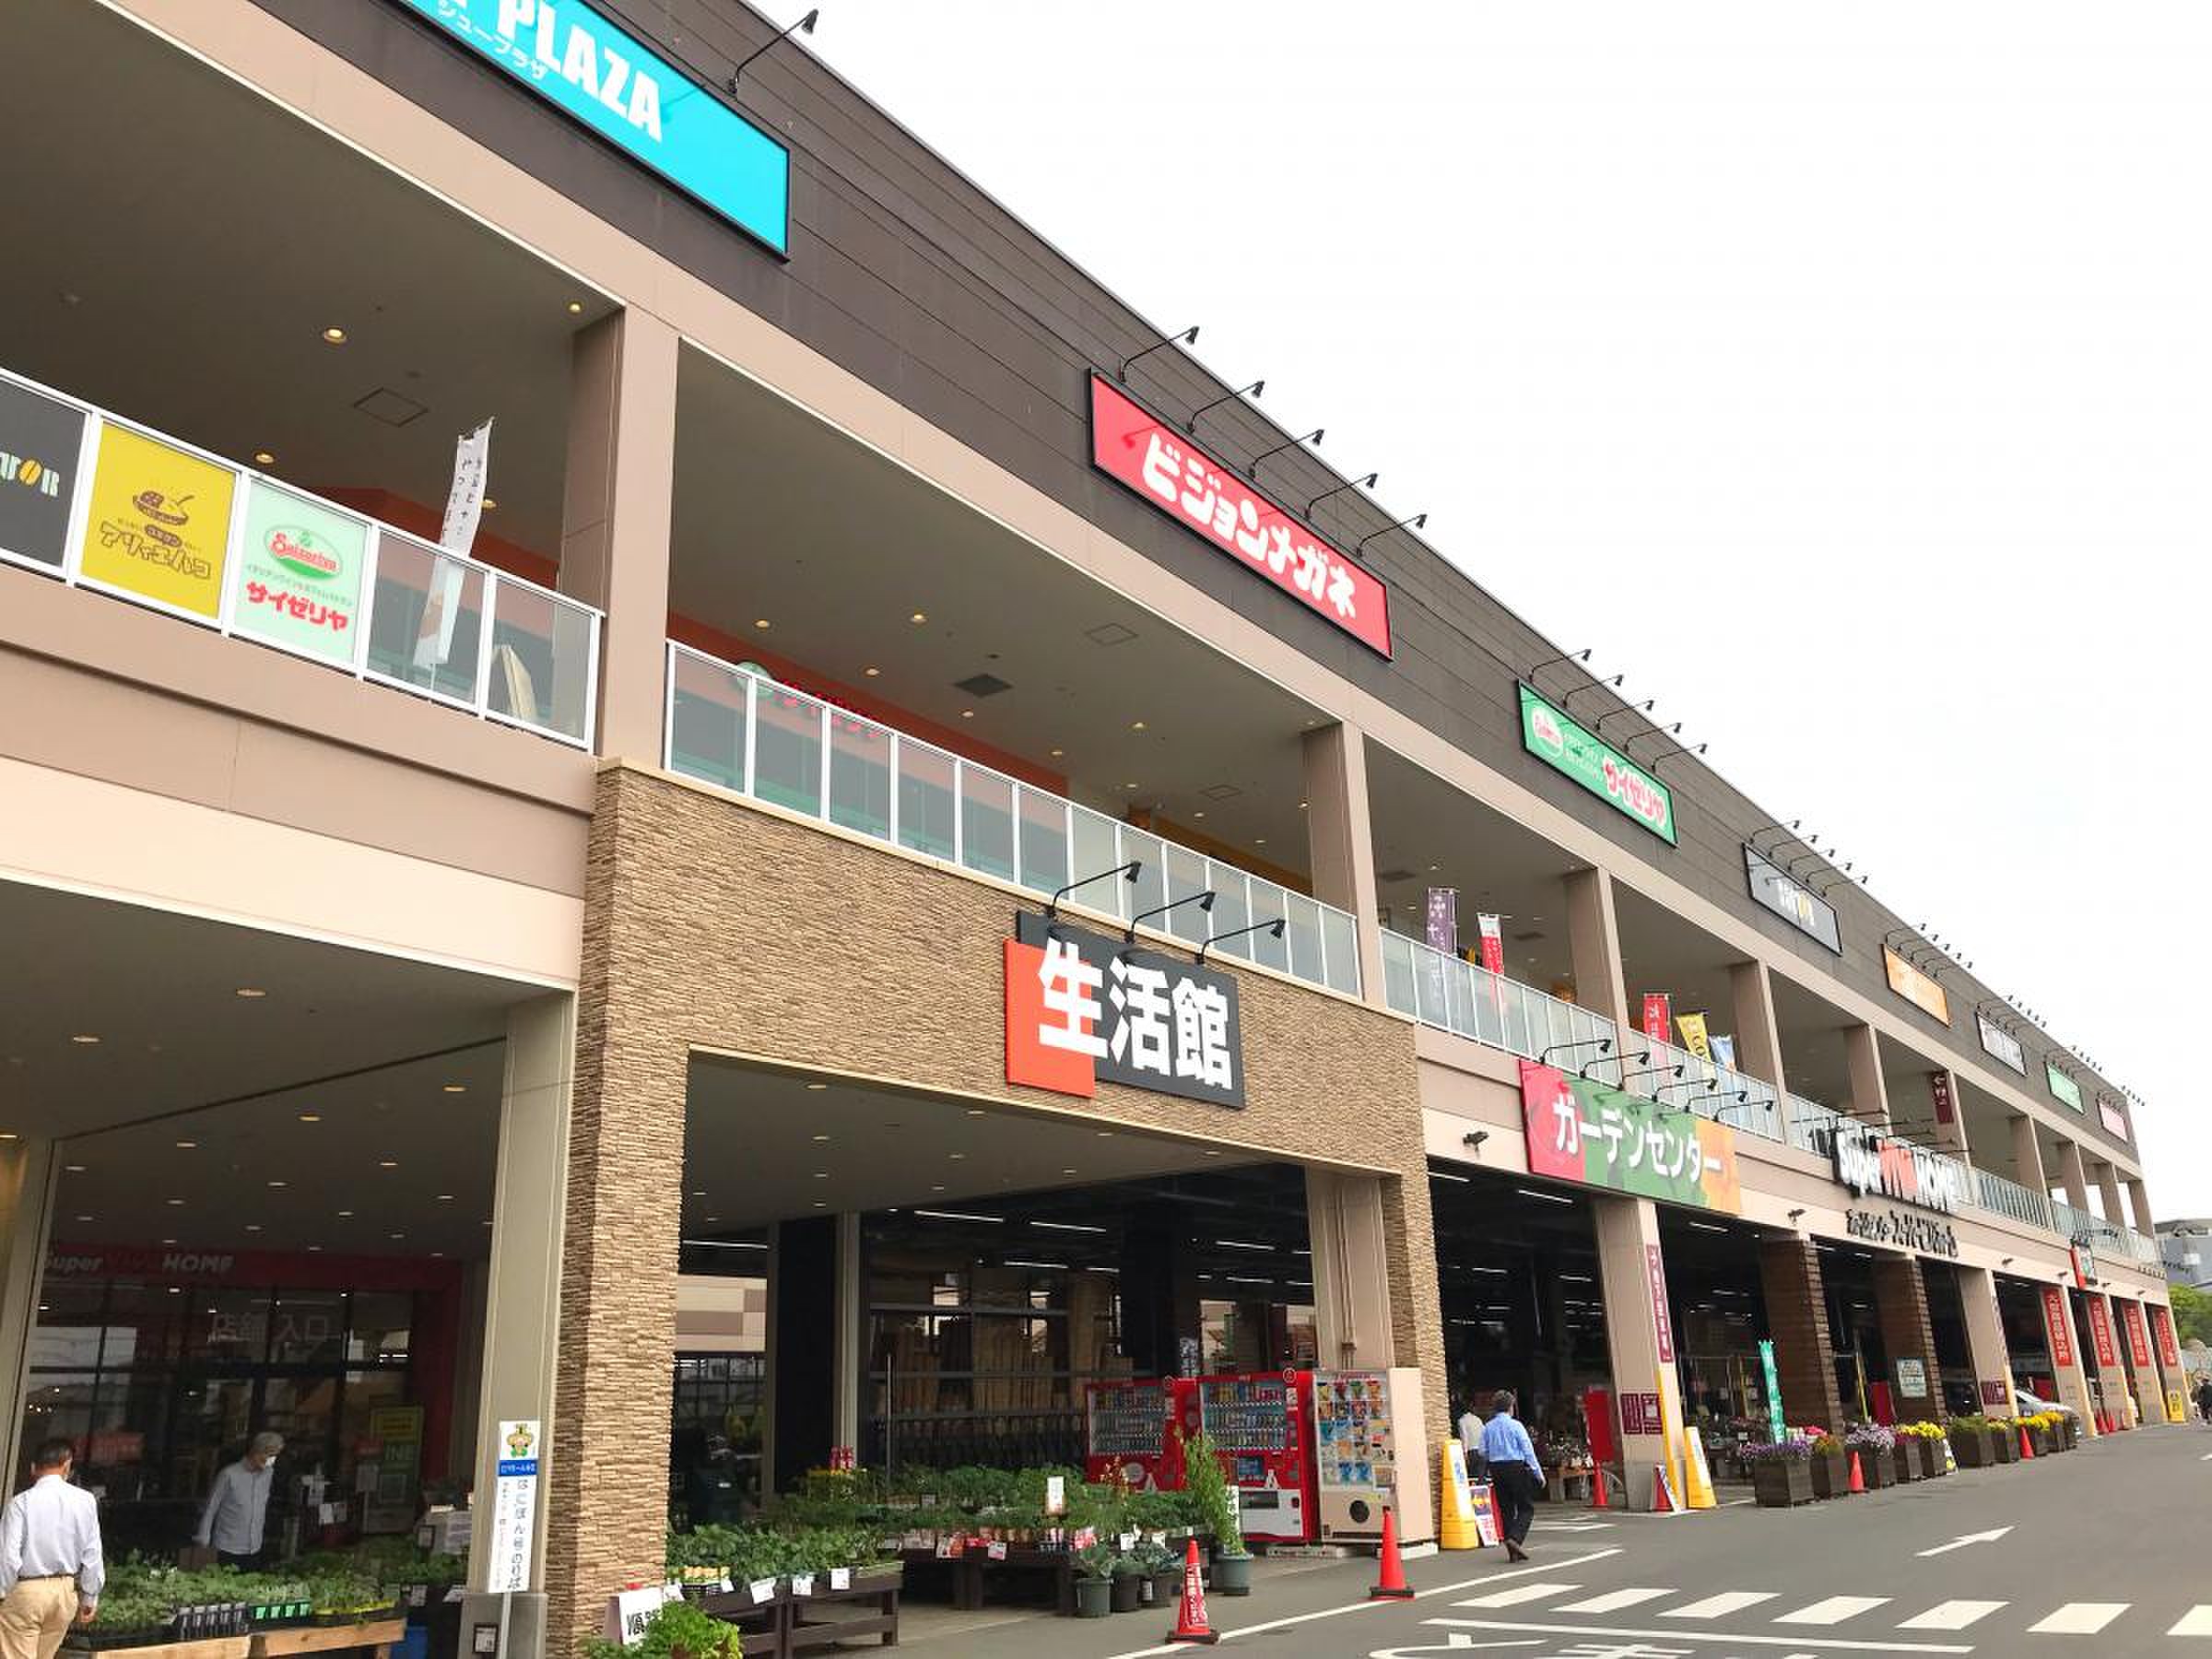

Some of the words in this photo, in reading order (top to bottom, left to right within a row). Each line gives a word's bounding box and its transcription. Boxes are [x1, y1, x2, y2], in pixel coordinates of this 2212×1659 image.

[497, 0, 662, 143] PLAZA
[1143, 432, 1356, 618] ビジョンメガネ
[246, 581, 348, 631] サイゼリヤ
[1038, 936, 1232, 1090] 生活館
[1553, 1093, 1722, 1182] ガーデンセンター
